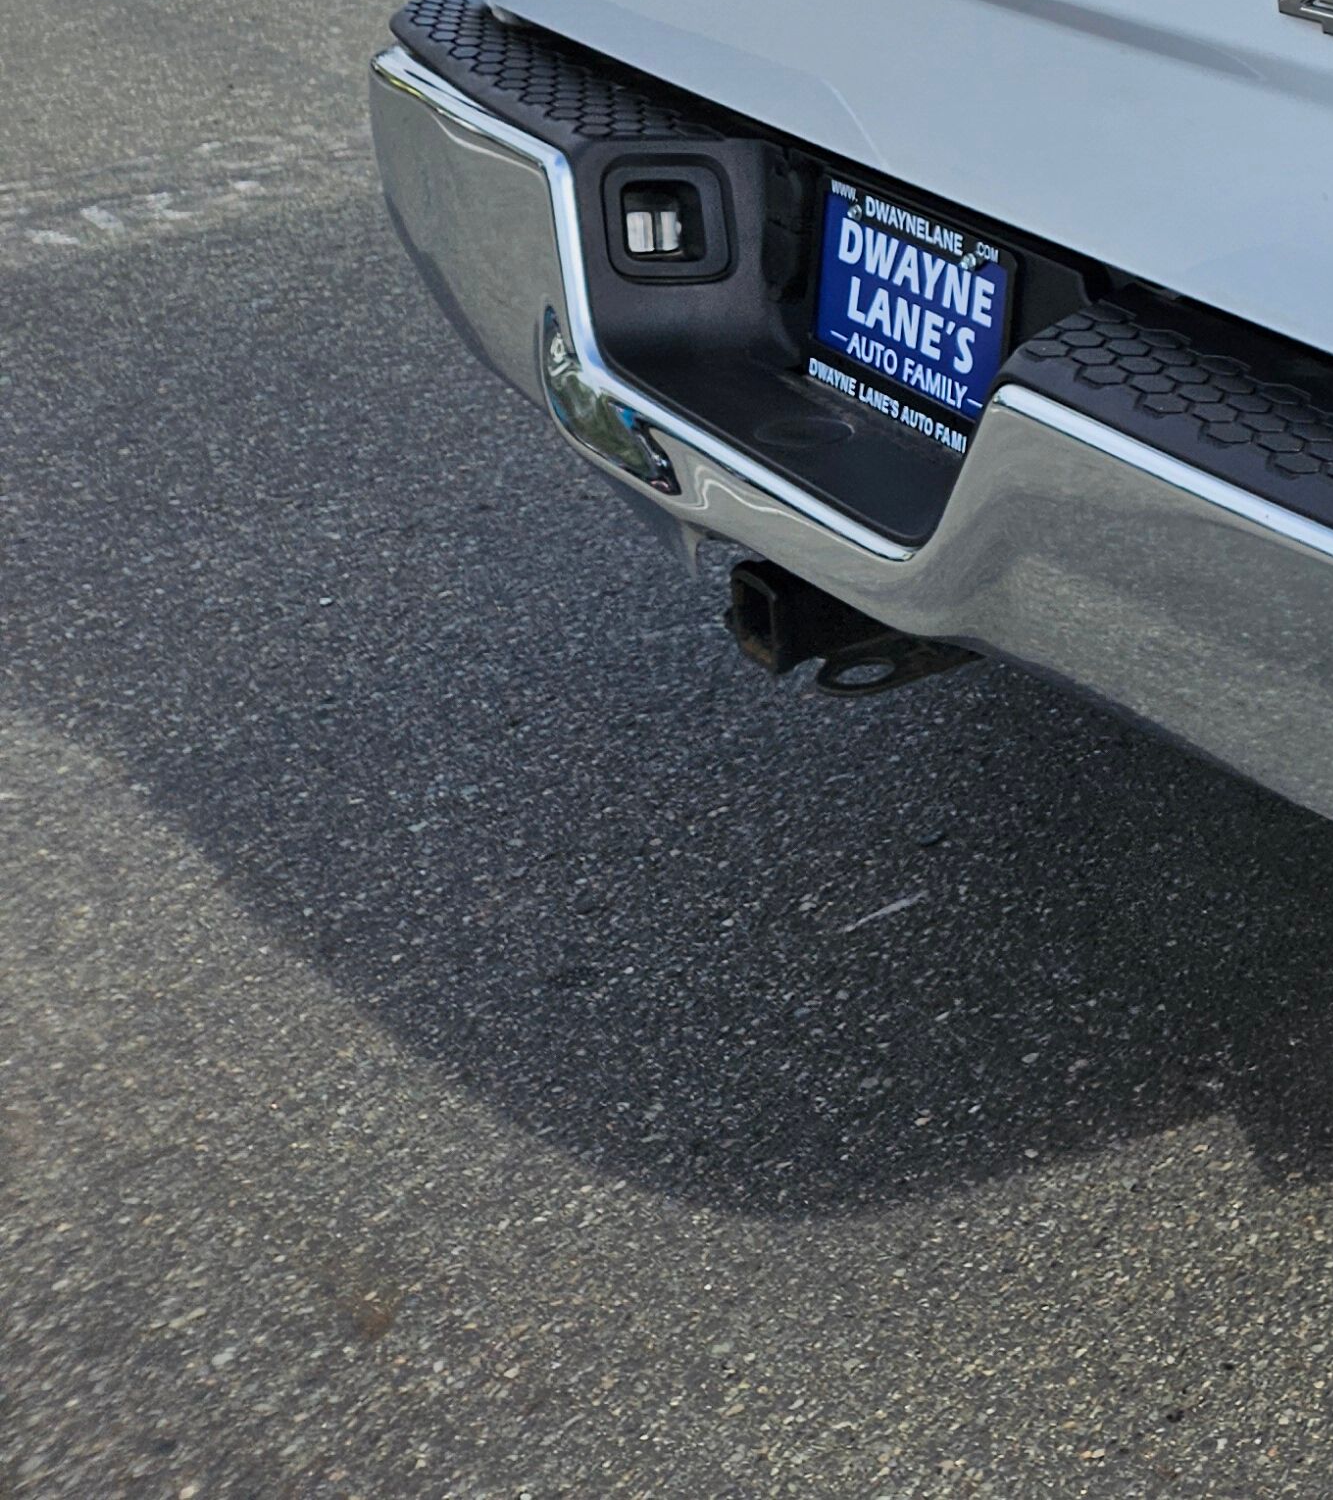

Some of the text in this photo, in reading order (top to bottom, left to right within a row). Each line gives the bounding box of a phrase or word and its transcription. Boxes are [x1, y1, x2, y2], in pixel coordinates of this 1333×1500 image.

[838, 217, 995, 328] DWAYNE
[865, 195, 963, 256] DWAYNELANE
[846, 332, 968, 409] AUTO FAMILY
[847, 276, 975, 374] LANE'S
[808, 358, 968, 455] DWAYNE LANE'S AUTO FAMI
